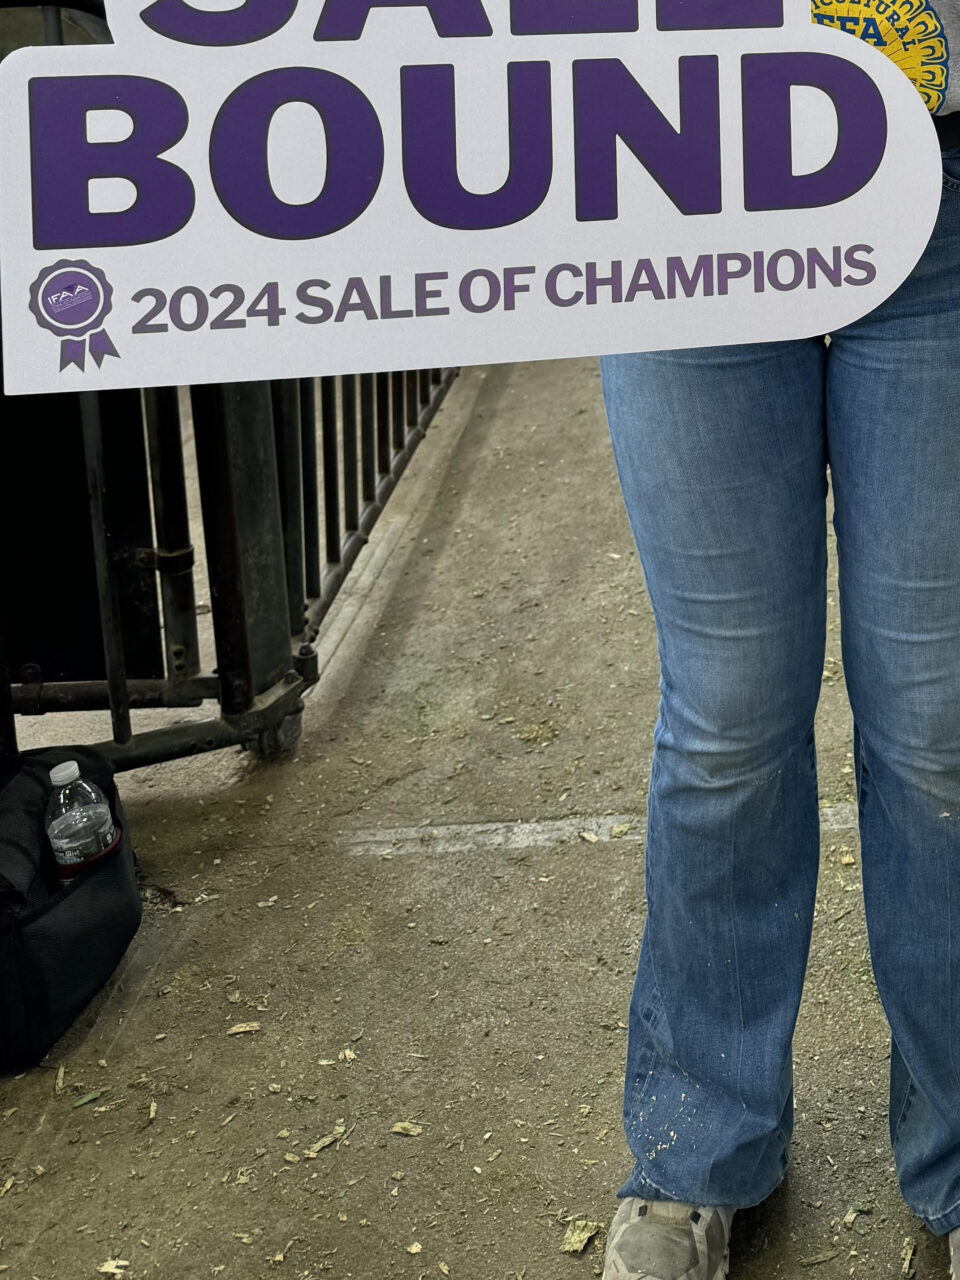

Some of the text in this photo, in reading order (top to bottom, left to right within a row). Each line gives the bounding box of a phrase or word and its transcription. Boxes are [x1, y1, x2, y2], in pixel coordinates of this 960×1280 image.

[27, 51, 888, 251] BOUND
[47, 284, 89, 306] IFAA
[131, 282, 286, 334] 2024
[295, 271, 450, 324] SALE
[459, 266, 536, 313] OF
[544, 243, 877, 308] CHAMPIONS
